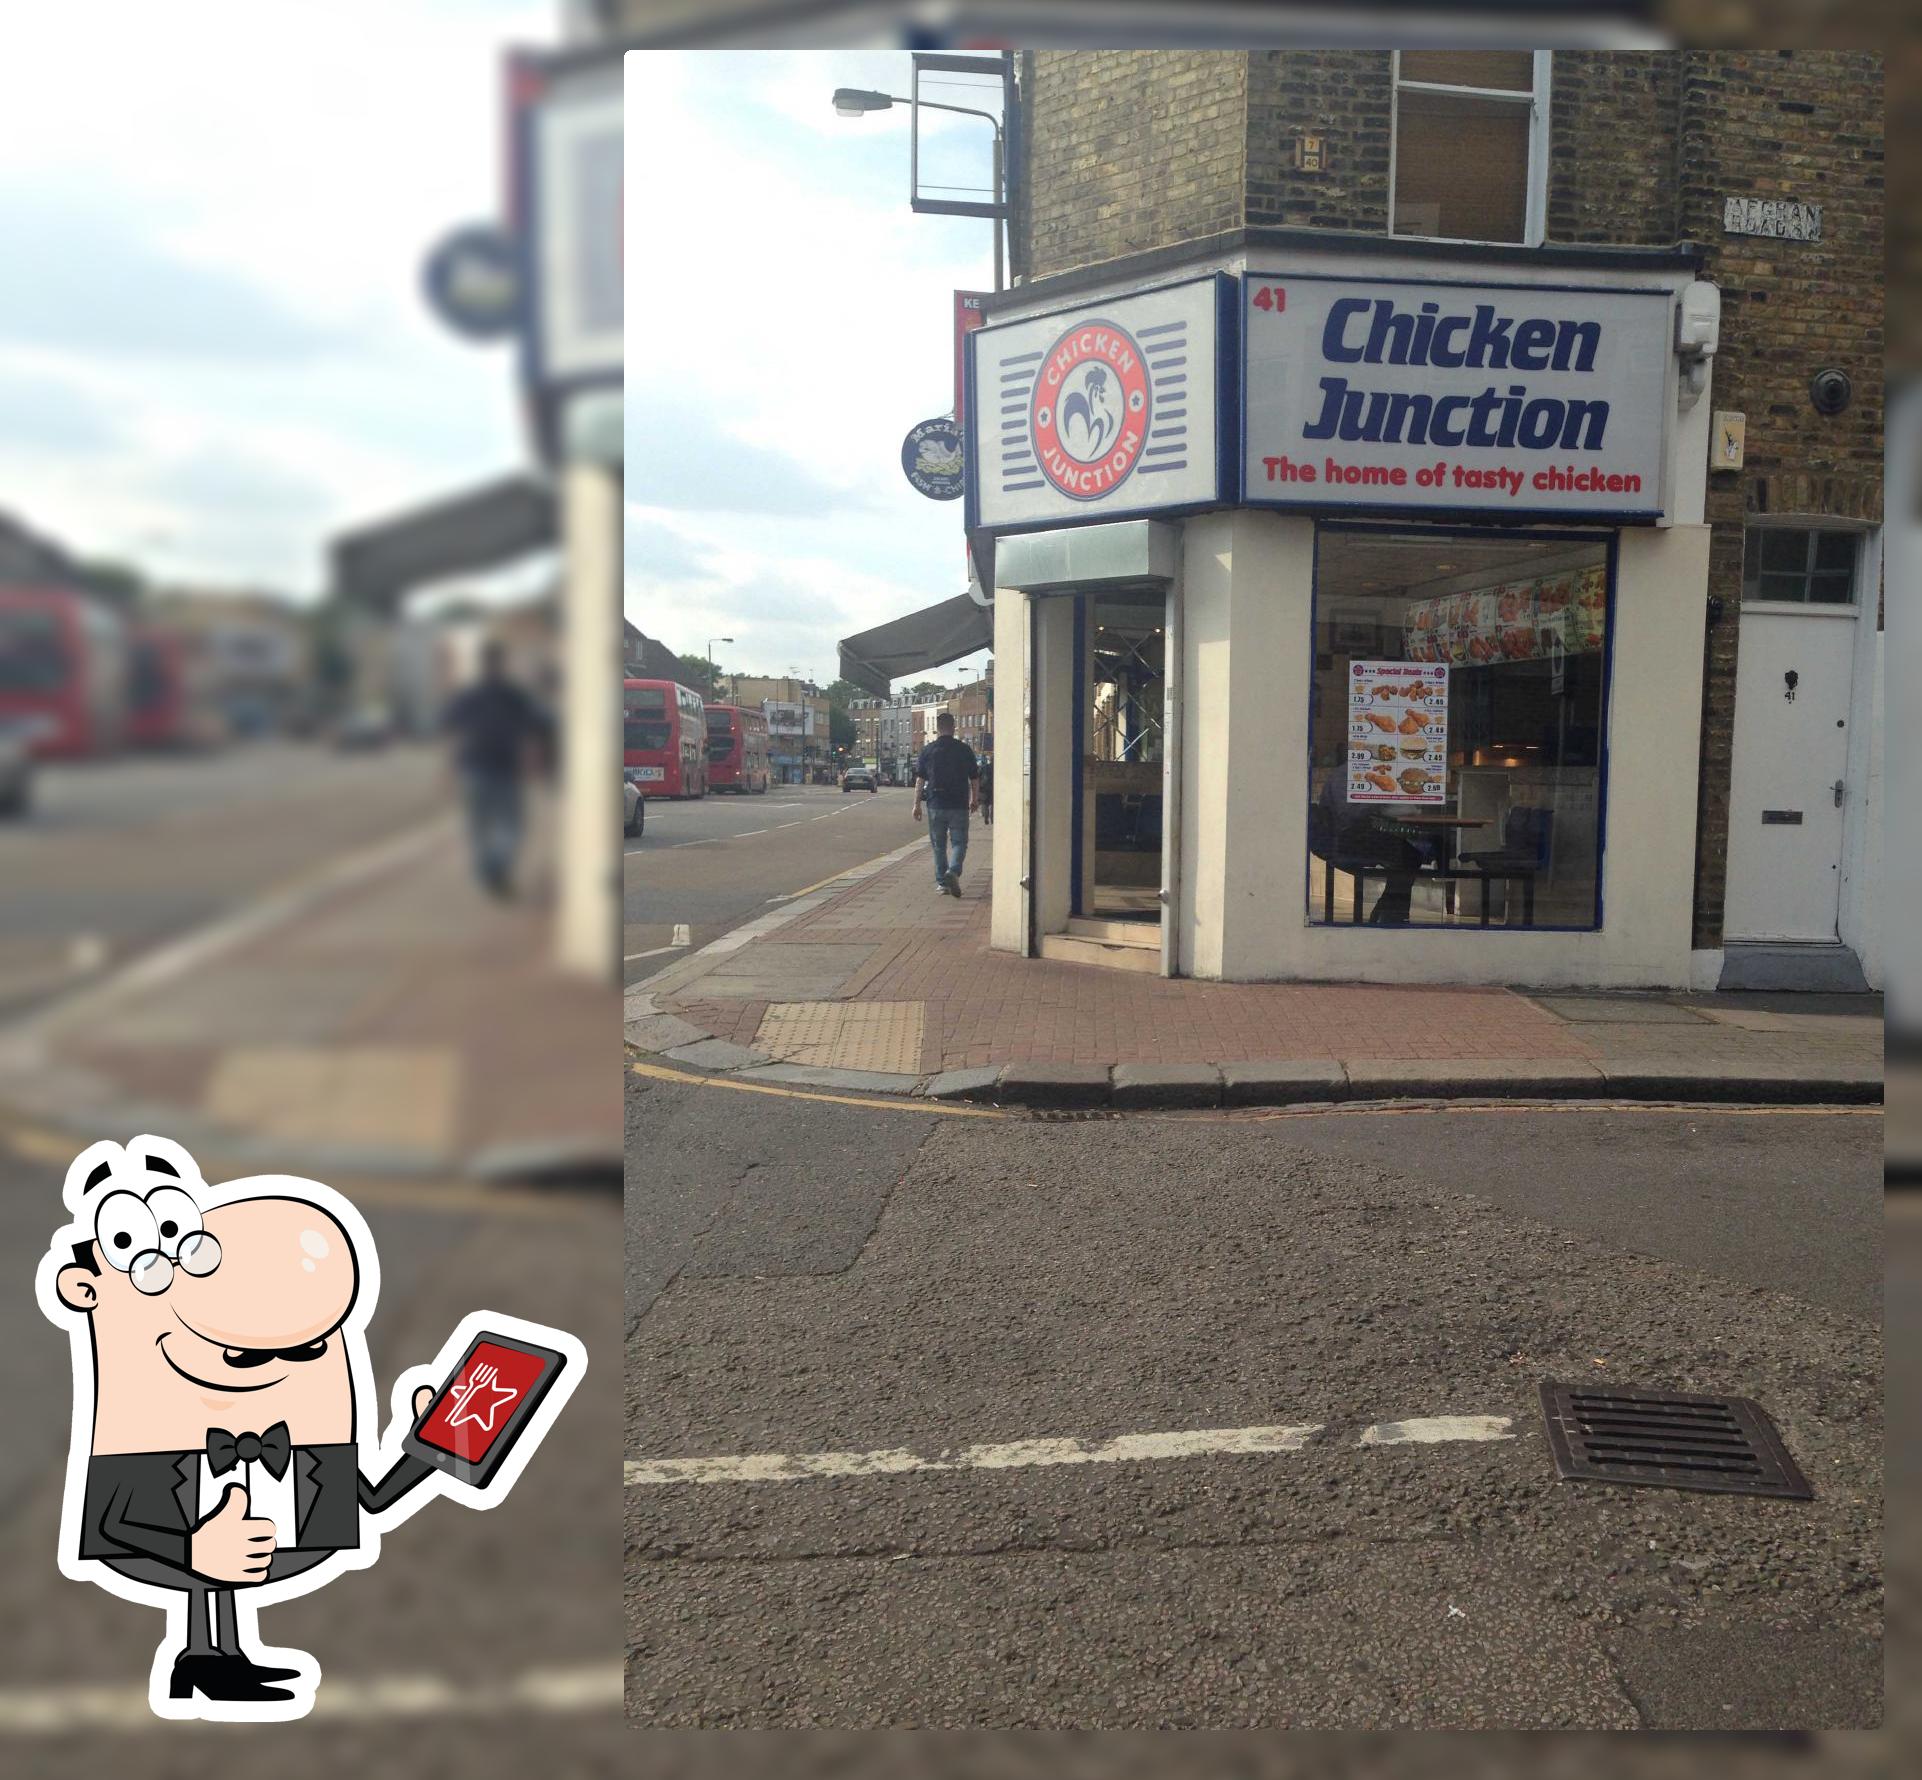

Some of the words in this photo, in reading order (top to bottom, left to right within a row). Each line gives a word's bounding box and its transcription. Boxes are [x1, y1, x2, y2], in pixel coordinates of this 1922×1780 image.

[1252, 287, 1286, 312] 41
[1047, 333, 1134, 385] CHICKEN
[1322, 298, 1602, 371] Chicken
[1302, 377, 1609, 450] Junction
[1043, 431, 1138, 490] JUNCTION
[1263, 456, 1316, 482] The
[1325, 458, 1406, 486] home
[1416, 461, 1446, 487] of
[1453, 463, 1524, 496] tasty
[1532, 466, 1641, 492] chicken
[1785, 691, 1795, 700] 41
